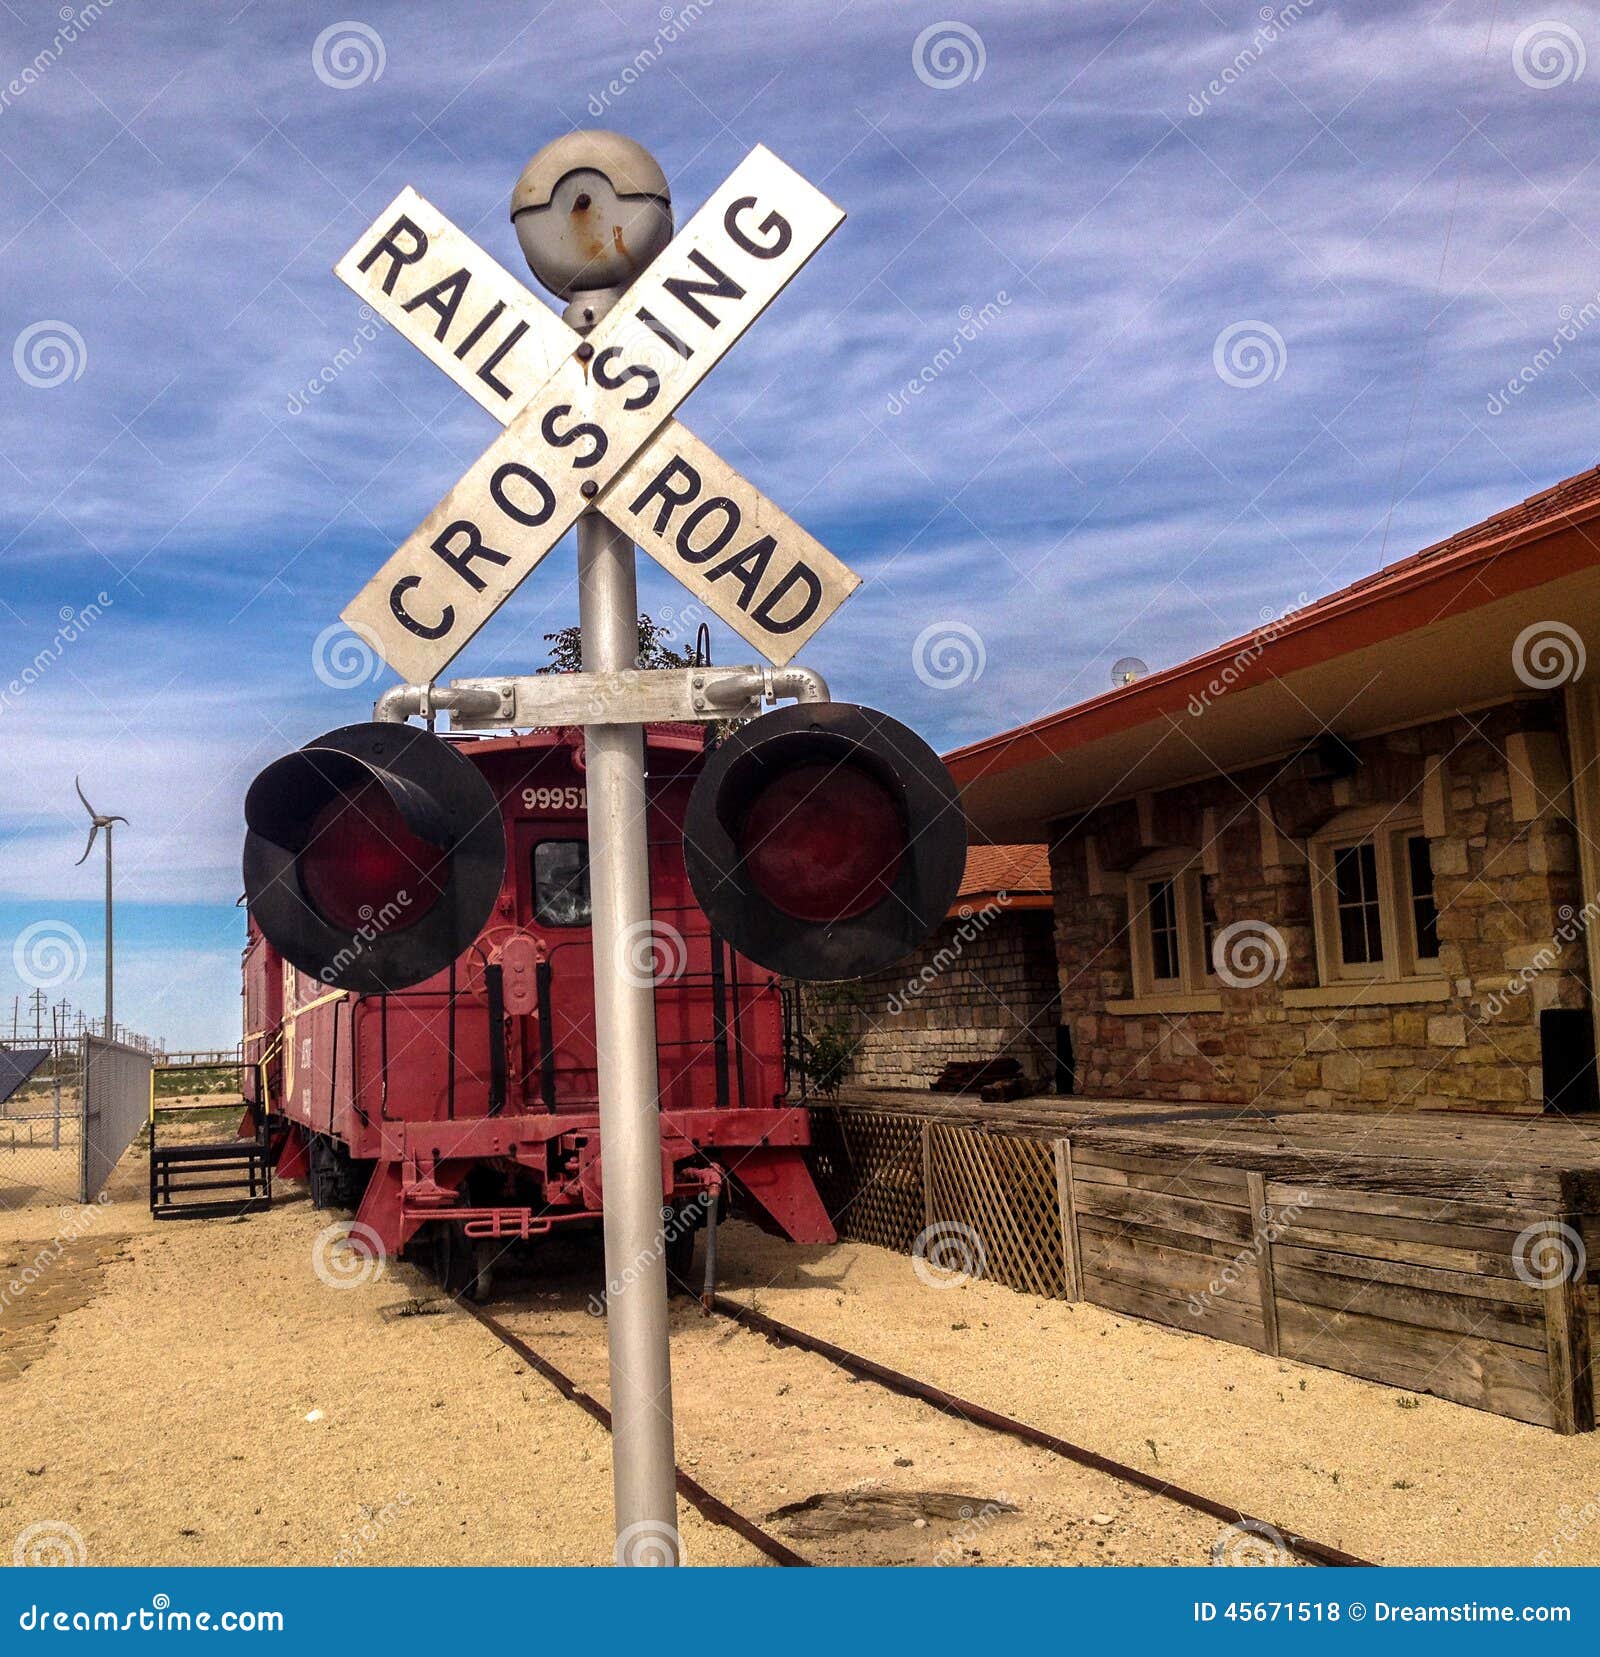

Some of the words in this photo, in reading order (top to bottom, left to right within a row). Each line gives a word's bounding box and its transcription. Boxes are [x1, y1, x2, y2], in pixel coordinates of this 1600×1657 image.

[357, 214, 528, 401] RAIL
[389, 196, 792, 640] CROSSING
[629, 455, 822, 635] ROAD
